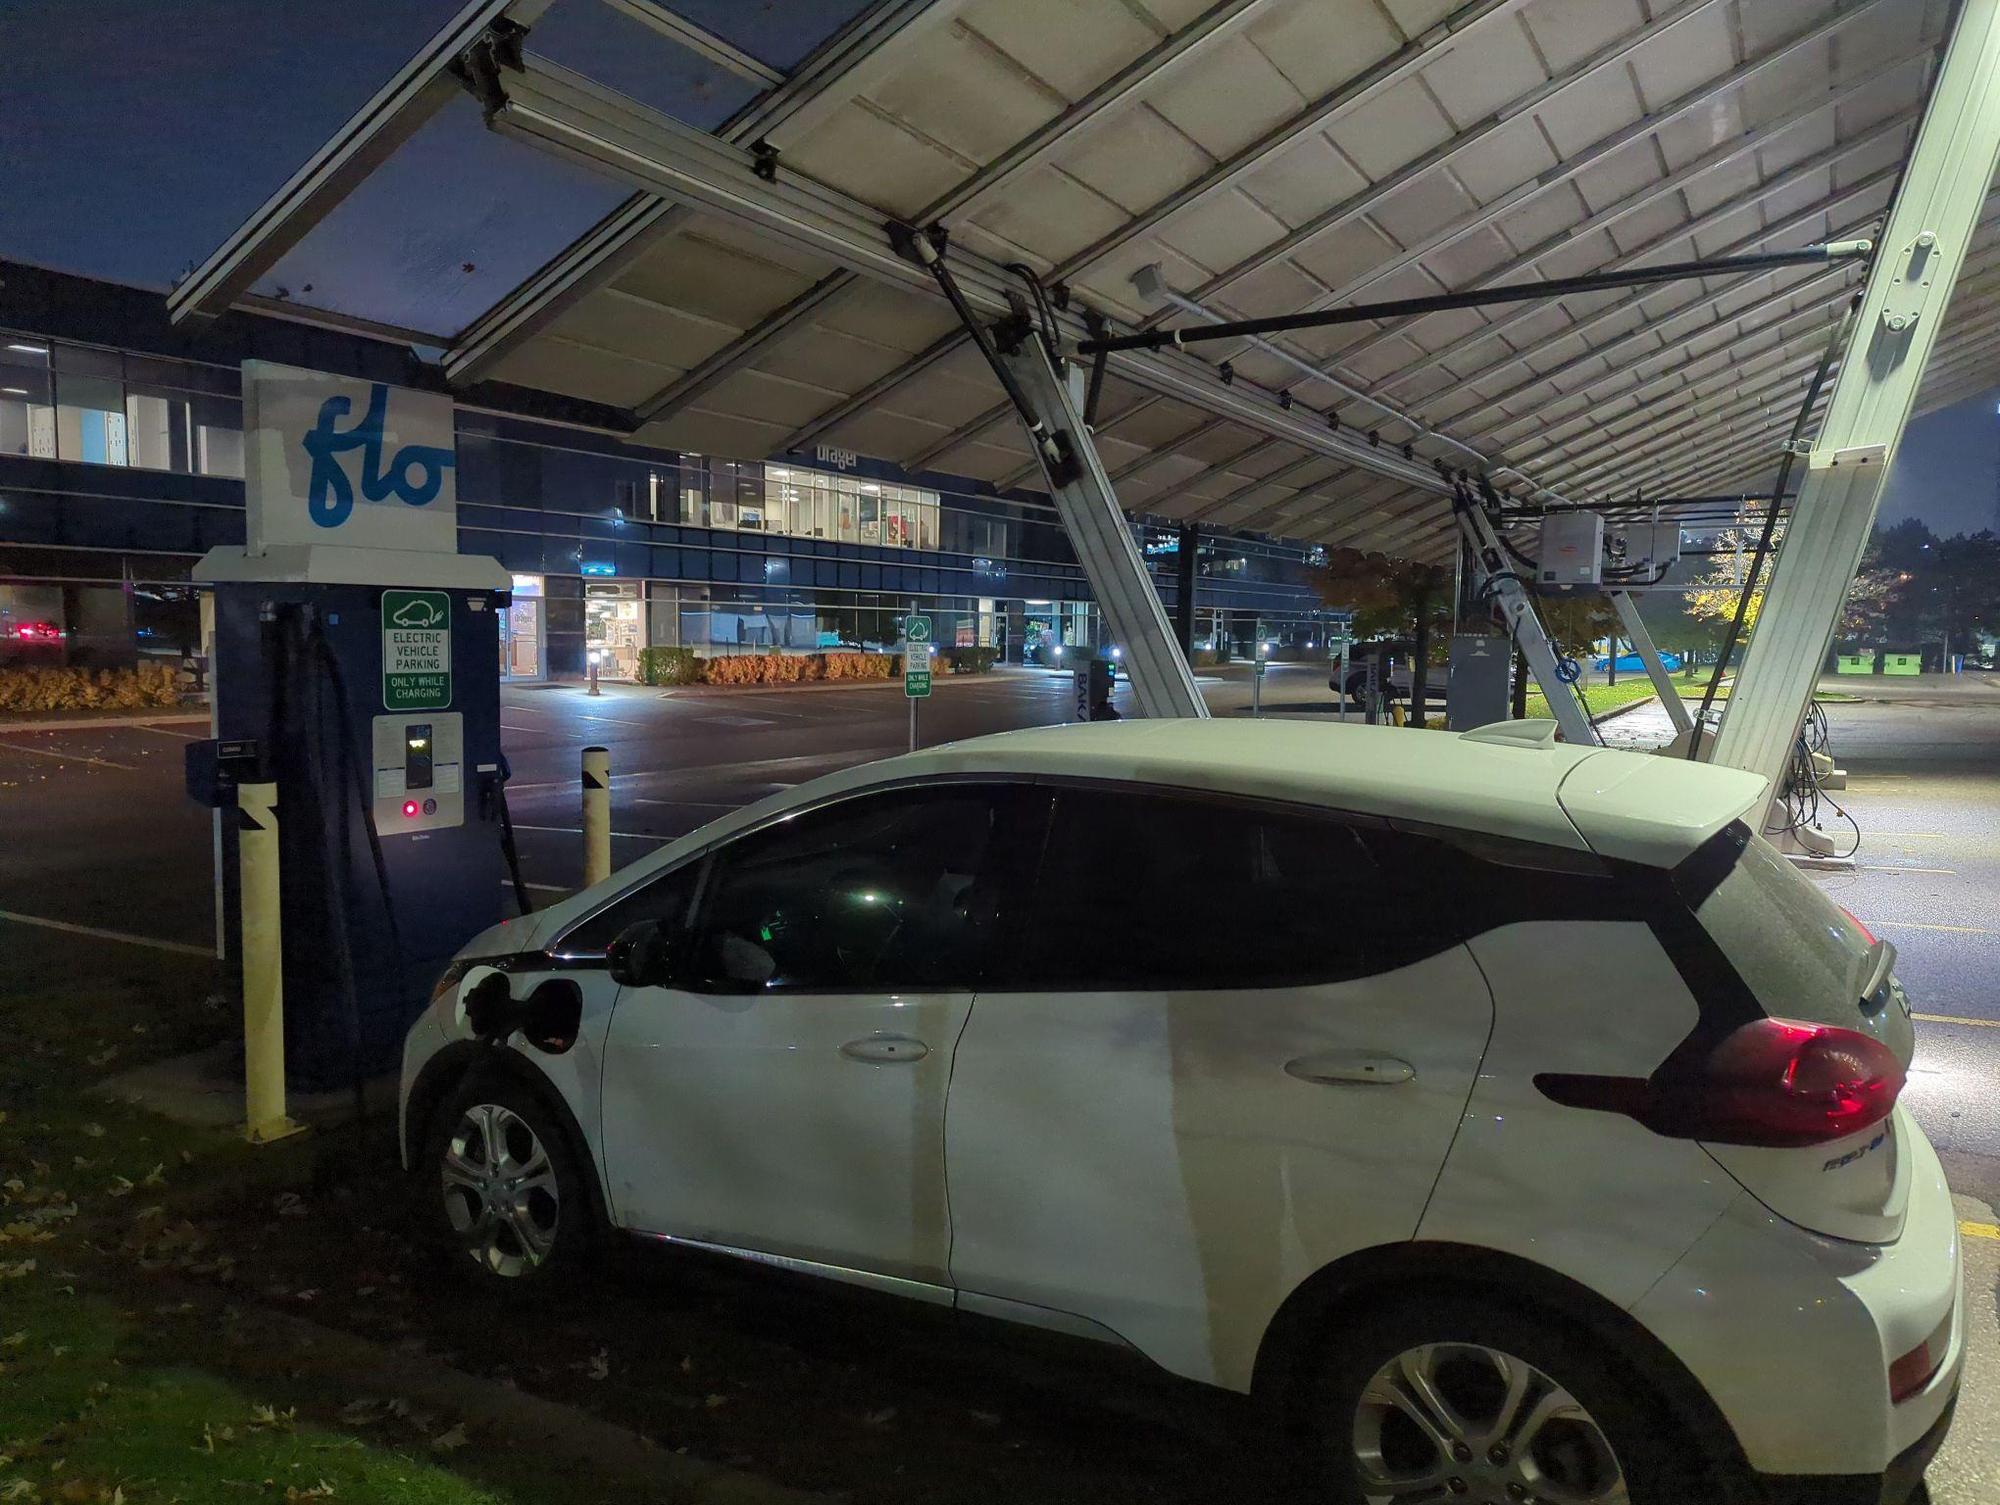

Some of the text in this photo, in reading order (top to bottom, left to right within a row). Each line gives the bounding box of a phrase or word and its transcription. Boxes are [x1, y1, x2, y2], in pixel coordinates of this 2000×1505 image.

[302, 383, 456, 528] flo
[393, 632, 441, 643] ELECTRIC
[397, 645, 439, 656] VEHICLE
[396, 659, 440, 670] PARKING
[391, 676, 445, 687] ONLY WHILE
[396, 688, 441, 699] CHARGING
